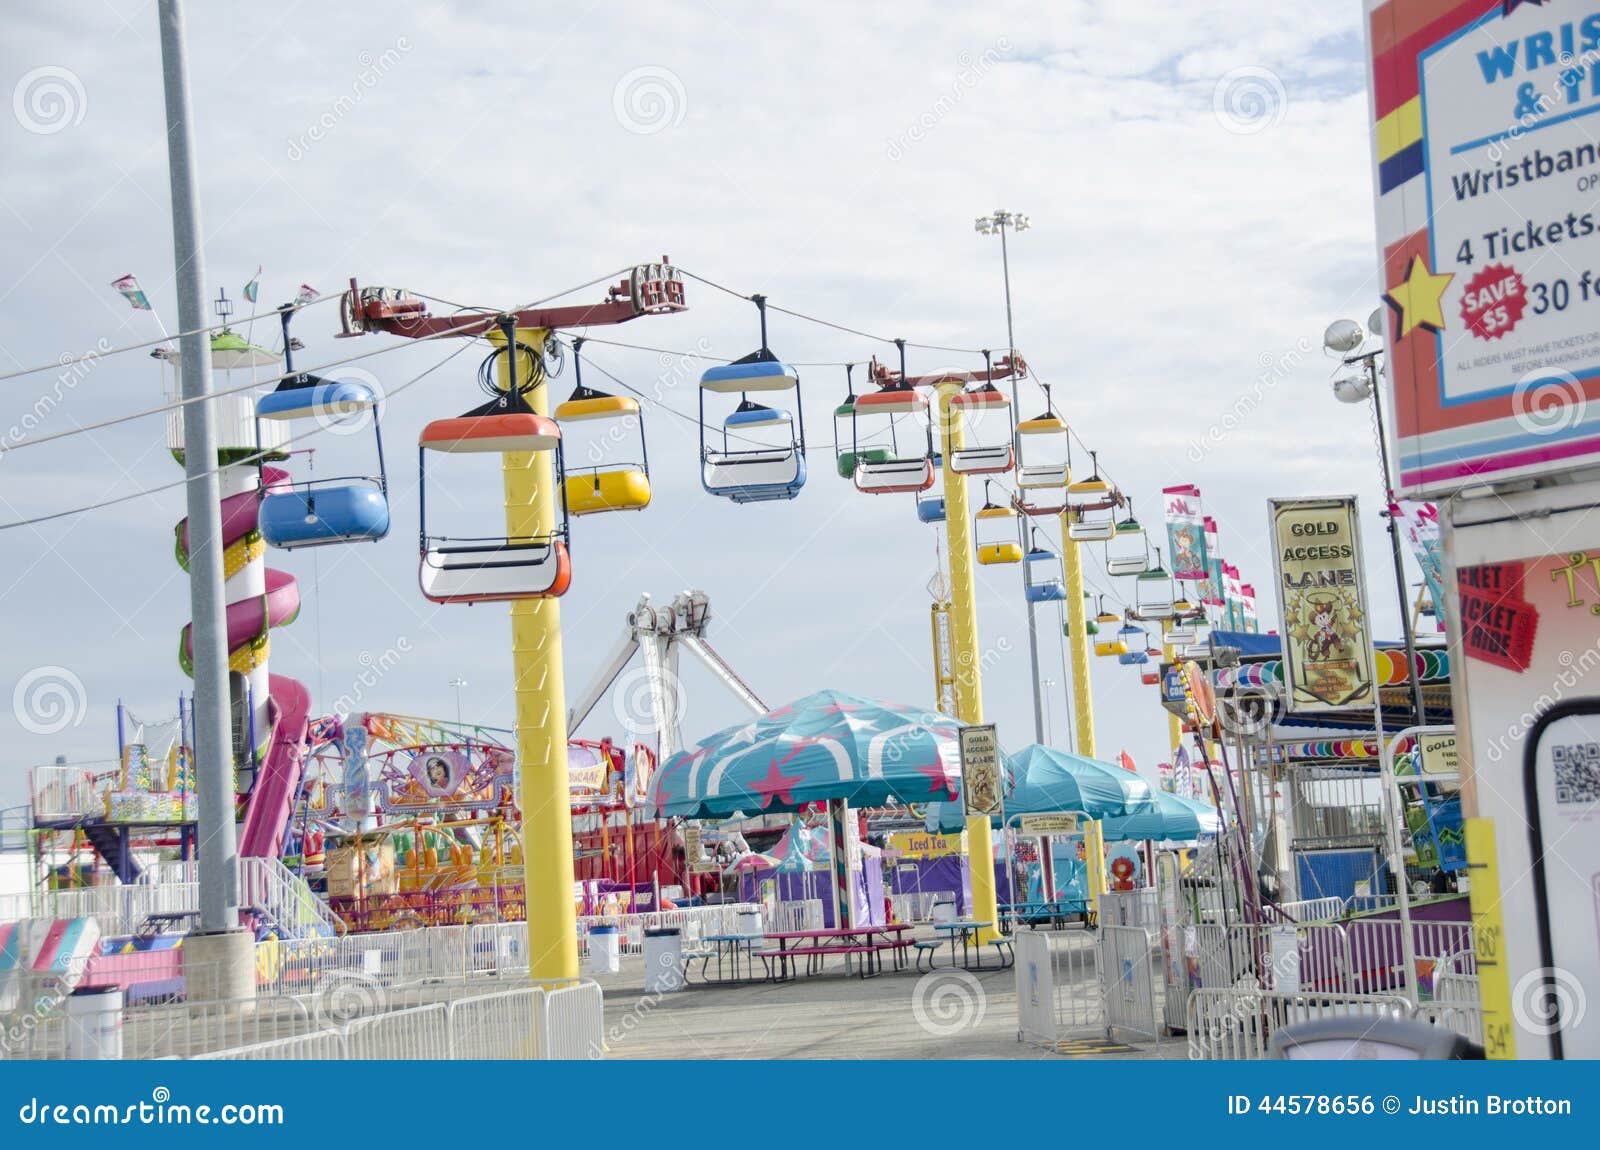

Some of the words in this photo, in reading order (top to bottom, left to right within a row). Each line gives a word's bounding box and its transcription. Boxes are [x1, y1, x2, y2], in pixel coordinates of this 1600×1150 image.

[1452, 142, 1600, 201] Wristban
[1577, 173, 1600, 192] OP
[1456, 239, 1474, 265] 4
[1464, 275, 1519, 314] SAVE
[1531, 279, 1570, 315] 30
[1482, 305, 1509, 332] $5
[1457, 361, 1472, 371] ALL
[295, 375, 308, 384] 13
[498, 397, 508, 409] 8
[1291, 521, 1339, 537] GOLD
[1283, 544, 1353, 562] ACCESS
[1283, 568, 1355, 590] LANE
[1426, 738, 1456, 752] GOLD
[908, 837, 929, 851] Iced
[930, 835, 947, 850] Tea
